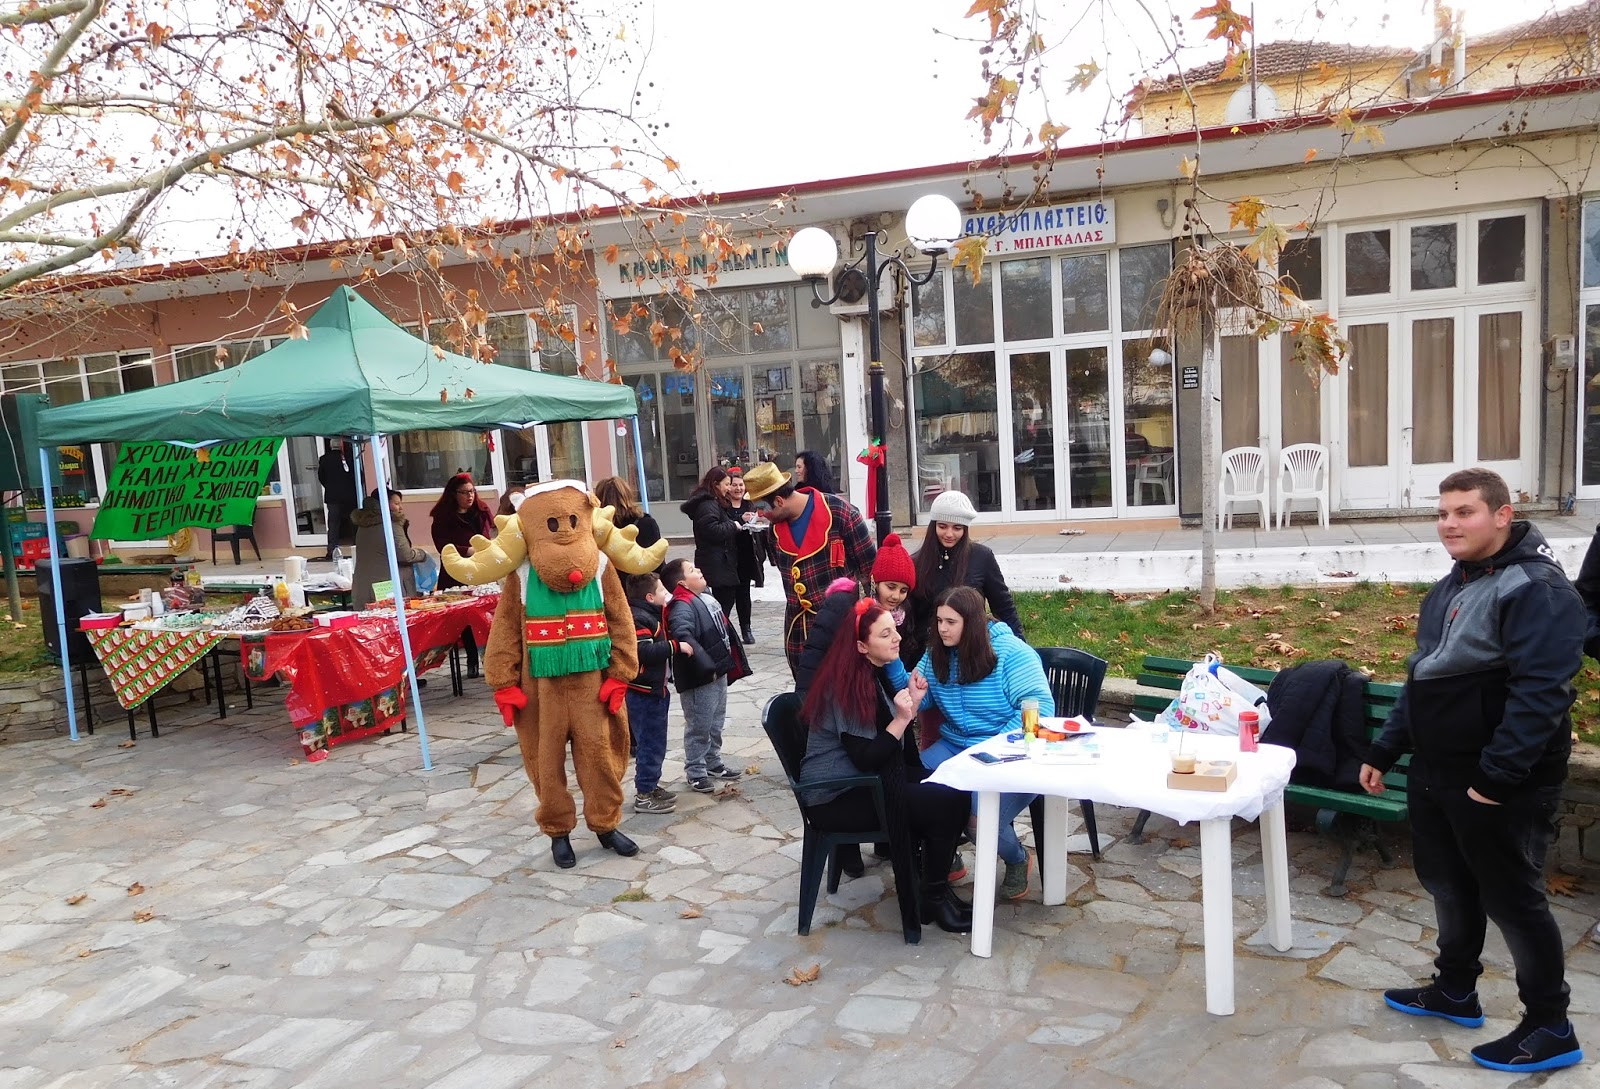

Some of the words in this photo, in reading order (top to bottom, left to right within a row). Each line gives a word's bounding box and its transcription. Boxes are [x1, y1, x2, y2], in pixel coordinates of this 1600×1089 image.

[959, 203, 1105, 237] ΑΧΑΡΟΠΛΑΣΤΕΙΟ
[1014, 230, 1104, 250] ΜΠΑΓΚΑΛΑΣ
[119, 465, 180, 487] ΚΑΛΗ
[183, 459, 260, 480] ΧΡΟΝΙΑ
[102, 483, 185, 511] ΔΗΜΟΤΙΚΟ
[194, 480, 260, 501] ΣΧΟΛΕΙΟ
[131, 503, 226, 534] ΤΕΡΠΝΗΣ
